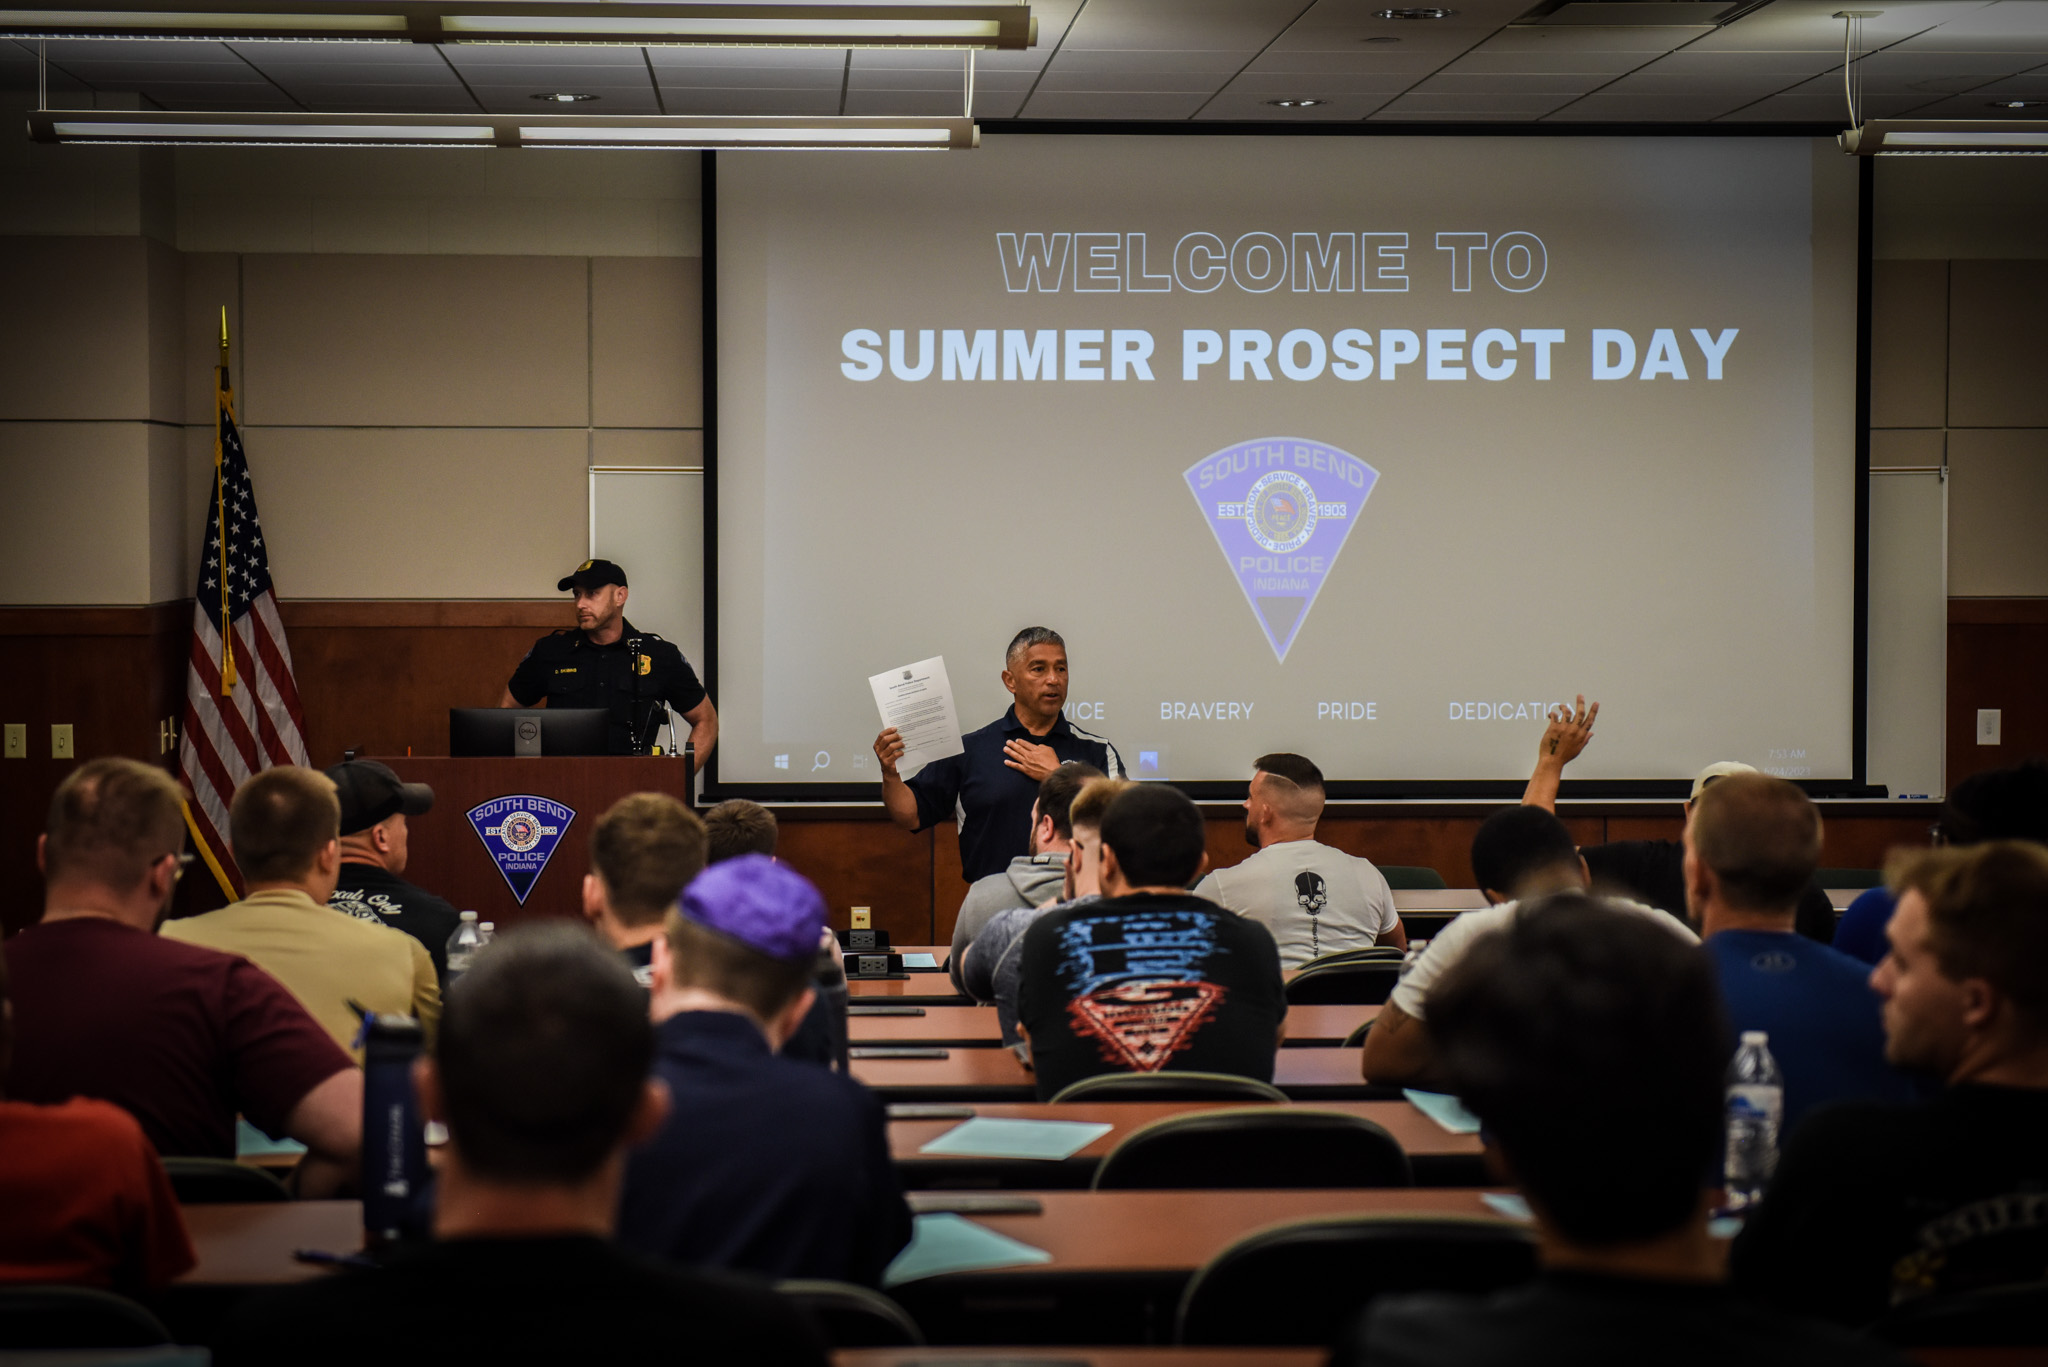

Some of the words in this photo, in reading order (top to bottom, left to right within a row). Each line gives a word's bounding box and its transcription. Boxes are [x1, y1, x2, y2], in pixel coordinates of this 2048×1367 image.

[996, 232, 1411, 295] WELCOME
[1435, 231, 1549, 294] TO
[840, 329, 1157, 383] SUMMER
[1182, 328, 1567, 383] PROSPECT
[1592, 328, 1741, 382] DAY
[1199, 444, 1285, 489] SOUTH
[1294, 445, 1364, 488] BEND
[1260, 472, 1301, 486] SERVICE
[1218, 504, 1245, 517] EST.
[1318, 504, 1347, 517] 1903
[1246, 486, 1268, 547] DEDICATION
[1302, 486, 1317, 535] BRAVERY
[1272, 540, 1302, 552] PRIDE
[1240, 556, 1324, 573] POLICE
[1253, 577, 1310, 590] INDIANA
[1160, 702, 1254, 720] BRAVERY
[1317, 702, 1378, 720] PRIDE
[1790, 749, 1806, 759] AM
[475, 799, 523, 821] SOUTH
[527, 799, 567, 820] BEND
[541, 827, 558, 835] 1903
[498, 852, 545, 861] POLICE
[330, 888, 364, 901] ocals
[367, 893, 403, 914] Only
